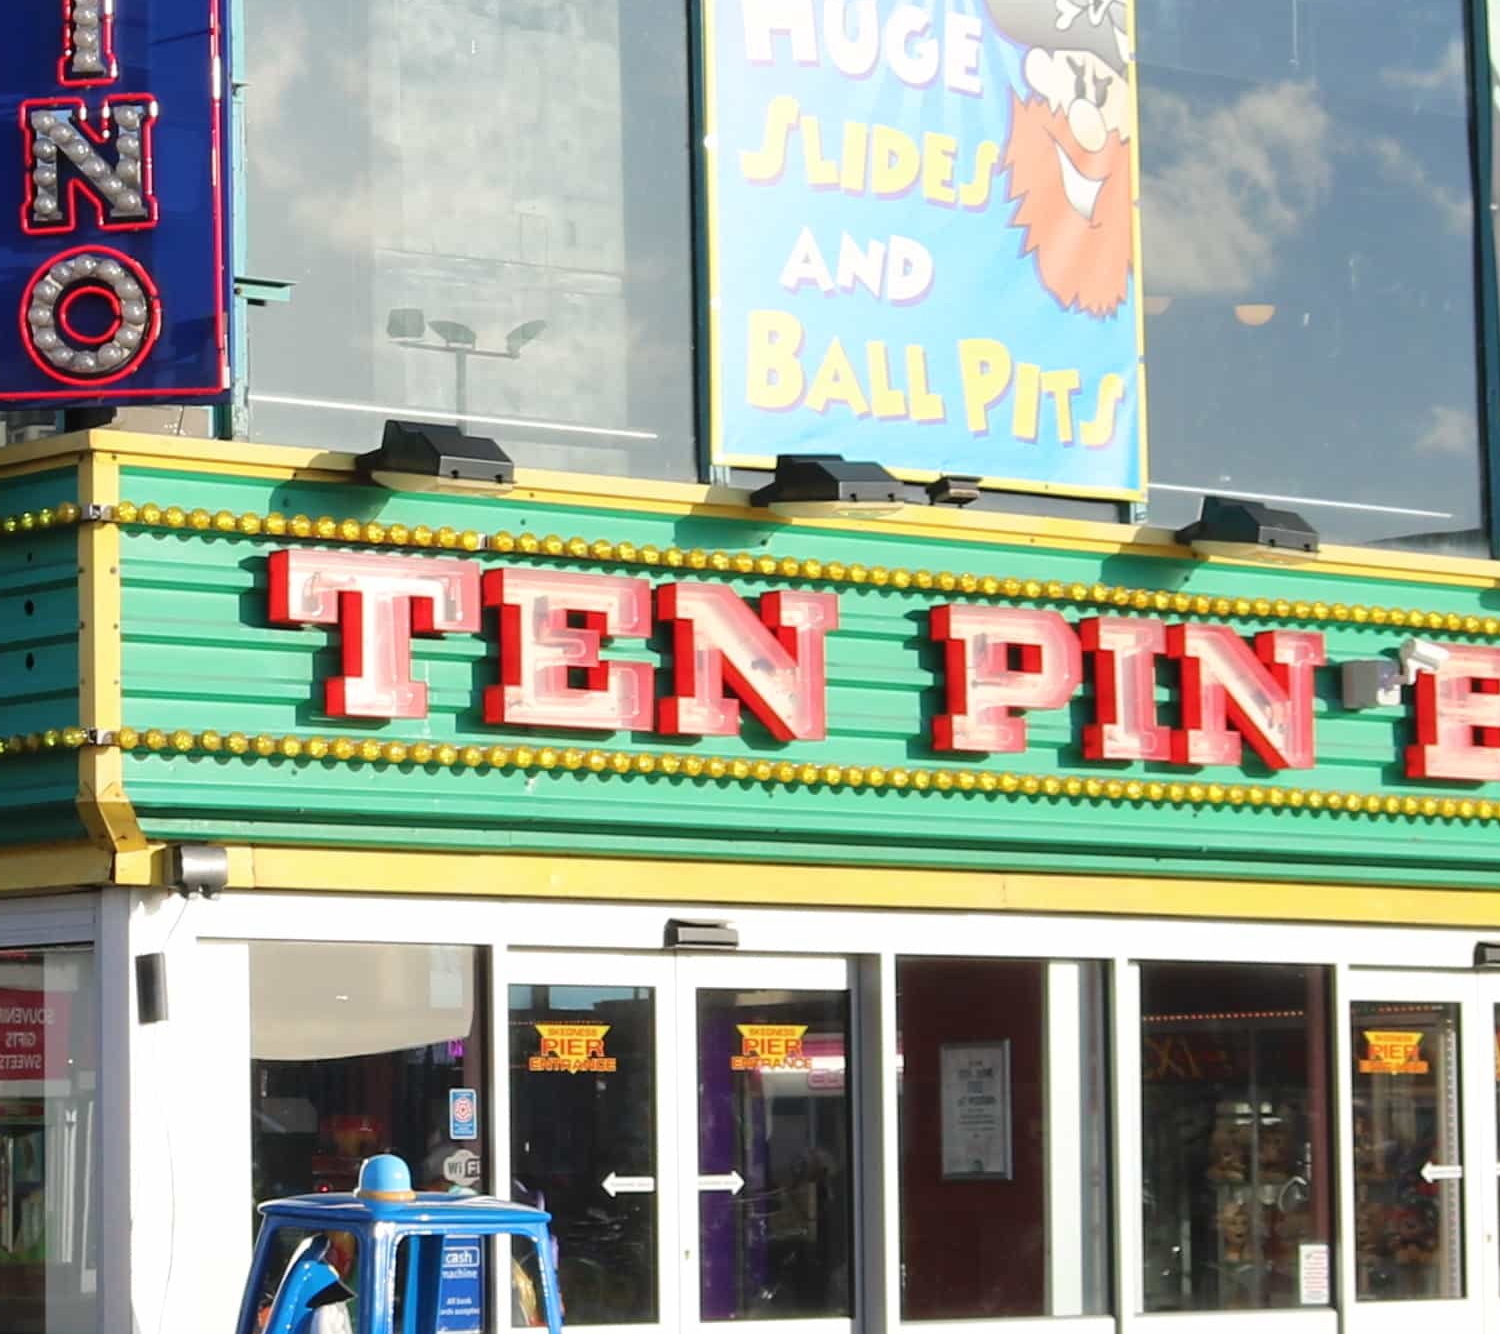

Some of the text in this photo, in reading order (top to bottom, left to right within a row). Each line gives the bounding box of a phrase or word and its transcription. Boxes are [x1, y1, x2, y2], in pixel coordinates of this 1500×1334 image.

[739, 96, 1001, 212] SLIDES
[779, 227, 934, 304] AND
[746, 309, 1126, 452] BALL PITS
[268, 547, 840, 744] TEN
[928, 601, 1326, 771] PIN
[541, 1038, 605, 1056] PIER
[743, 1038, 801, 1056] PIER
[1369, 1044, 1418, 1059] PIER
[529, 1057, 616, 1071] ENTRANCE
[731, 1057, 812, 1070] ENTRANCE
[446, 1251, 473, 1264] cash
